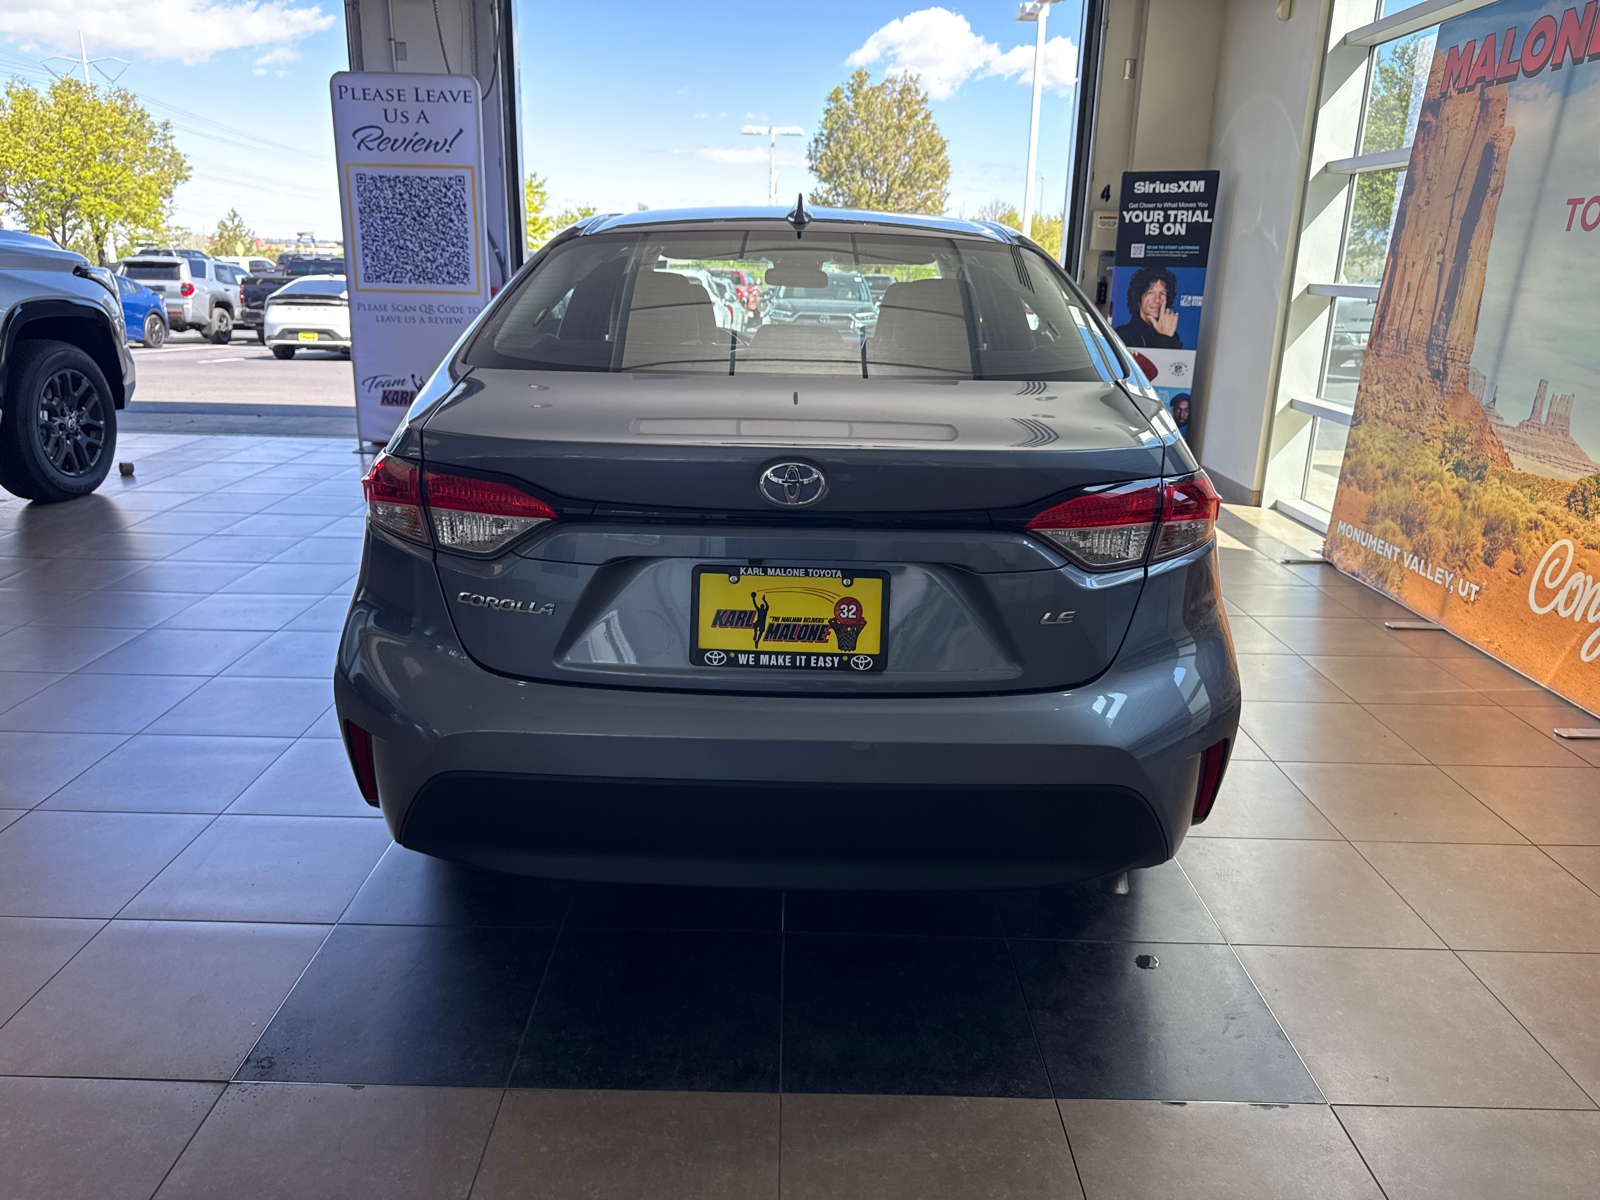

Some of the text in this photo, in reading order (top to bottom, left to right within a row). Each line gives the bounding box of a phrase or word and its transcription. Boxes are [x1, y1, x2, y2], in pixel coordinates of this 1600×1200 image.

[337, 85, 472, 103] PLEASE LEAVE
[383, 108, 430, 124] US A
[352, 125, 463, 153] Review!
[1100, 184, 1111, 202] 4
[1134, 180, 1205, 194] SiriusXM
[1122, 210, 1213, 223] YOUR TRIAL
[1145, 223, 1187, 236] IS ON
[357, 302, 480, 315] PLEASE SCAN QR CODE TO
[375, 314, 464, 324] LEAVE US A REVIEW
[361, 374, 409, 393] Team
[1337, 520, 1480, 602] MONUMENT VALLEY, UT
[740, 567, 843, 578] KARL MALONE TOYOTA
[457, 591, 556, 616] COROLLA
[711, 609, 757, 629] KARL
[839, 604, 857, 619] 32
[1040, 610, 1076, 625] LE
[763, 622, 831, 644] MALONE
[738, 653, 840, 668] WE MAKE IT EASY
